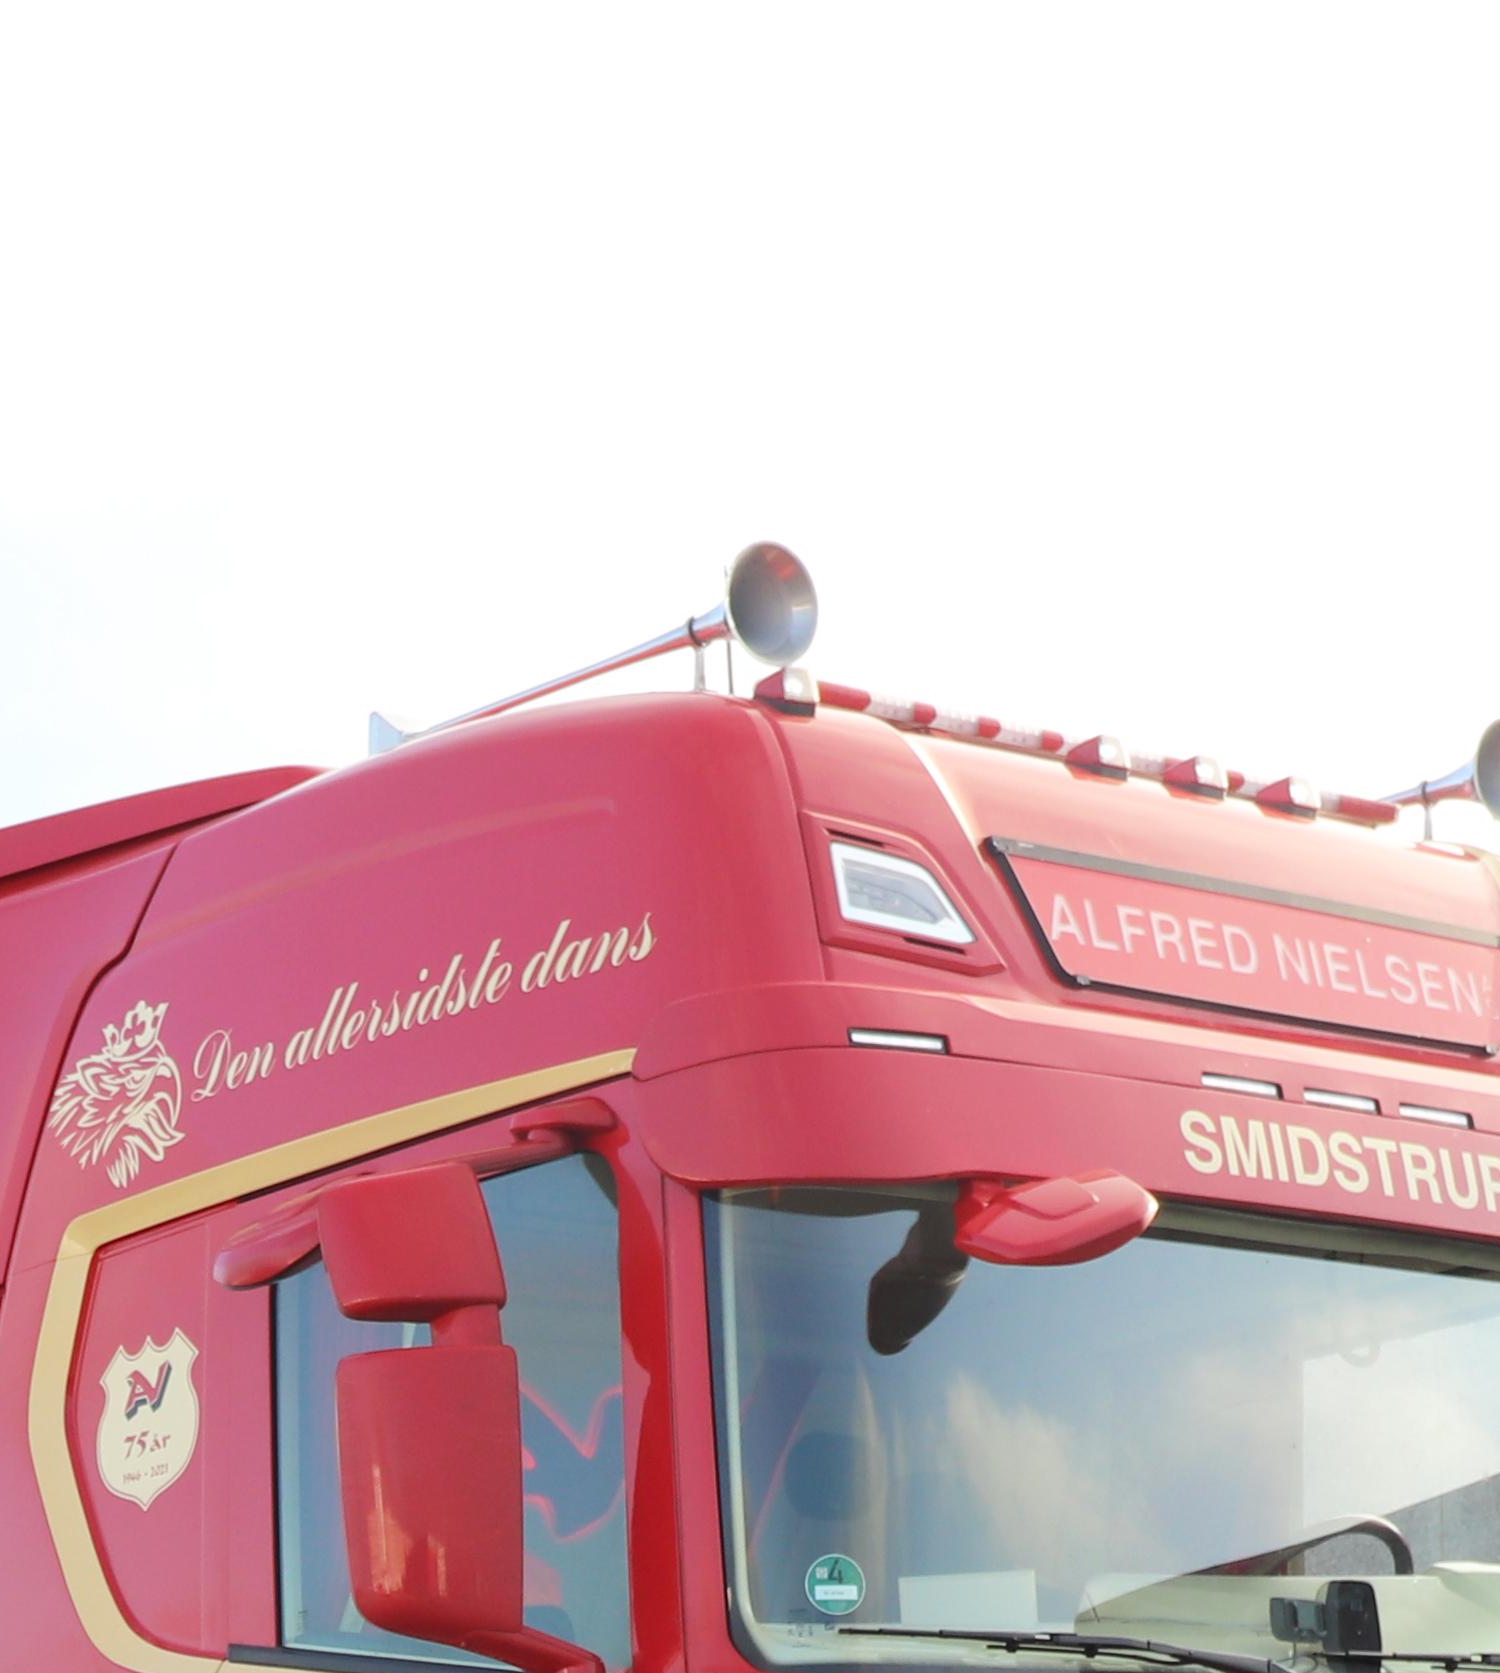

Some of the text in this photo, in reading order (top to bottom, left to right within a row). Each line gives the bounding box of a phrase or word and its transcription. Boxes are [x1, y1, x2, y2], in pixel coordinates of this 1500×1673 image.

[1050, 893, 1259, 976] ALFRED
[1271, 934, 1484, 1017] NIELSEN
[190, 911, 658, 1102] Den allersidste dans
[124, 1431, 150, 1460] 75
[827, 1558, 844, 1585] 4
